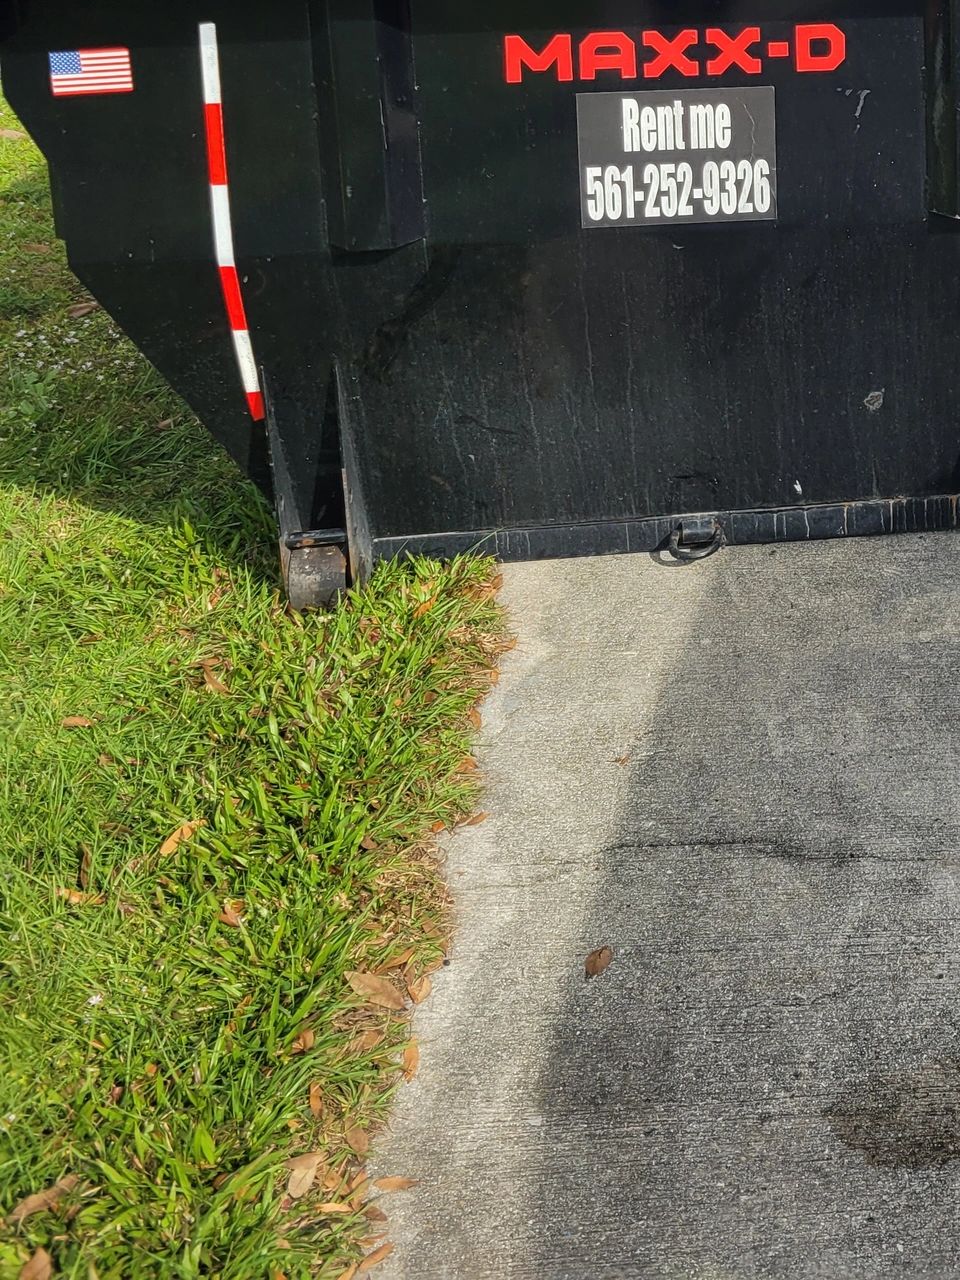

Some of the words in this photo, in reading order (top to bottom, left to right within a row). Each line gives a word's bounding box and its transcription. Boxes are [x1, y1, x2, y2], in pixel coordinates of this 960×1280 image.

[504, 23, 847, 84] MAXX-D
[621, 98, 686, 152] Rent
[690, 102, 732, 150] me
[585, 159, 771, 221] 561-252-9326
